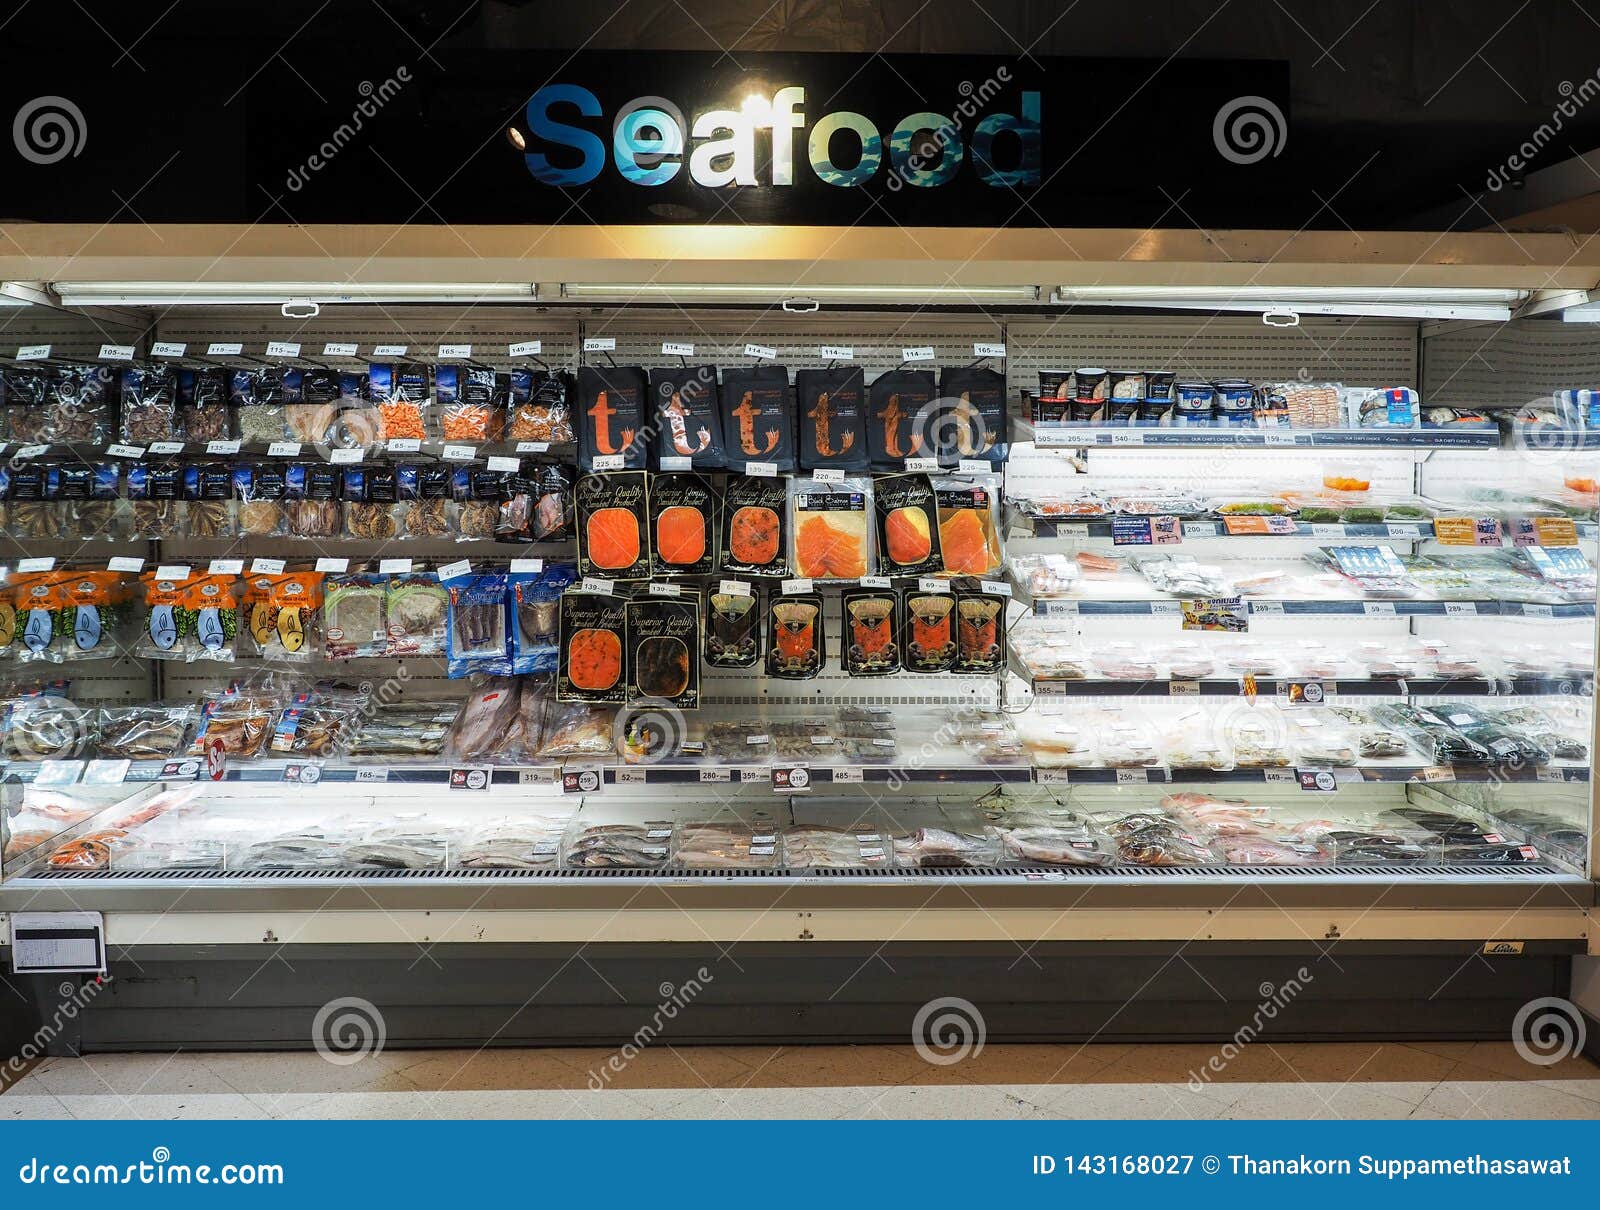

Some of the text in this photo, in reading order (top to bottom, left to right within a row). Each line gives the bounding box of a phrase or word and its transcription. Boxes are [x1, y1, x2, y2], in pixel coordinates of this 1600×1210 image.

[524, 84, 1042, 188] Seafood
[616, 485, 642, 498] Quality
[565, 608, 624, 620] Superior Qualit
[631, 614, 694, 629] Superior Quality
